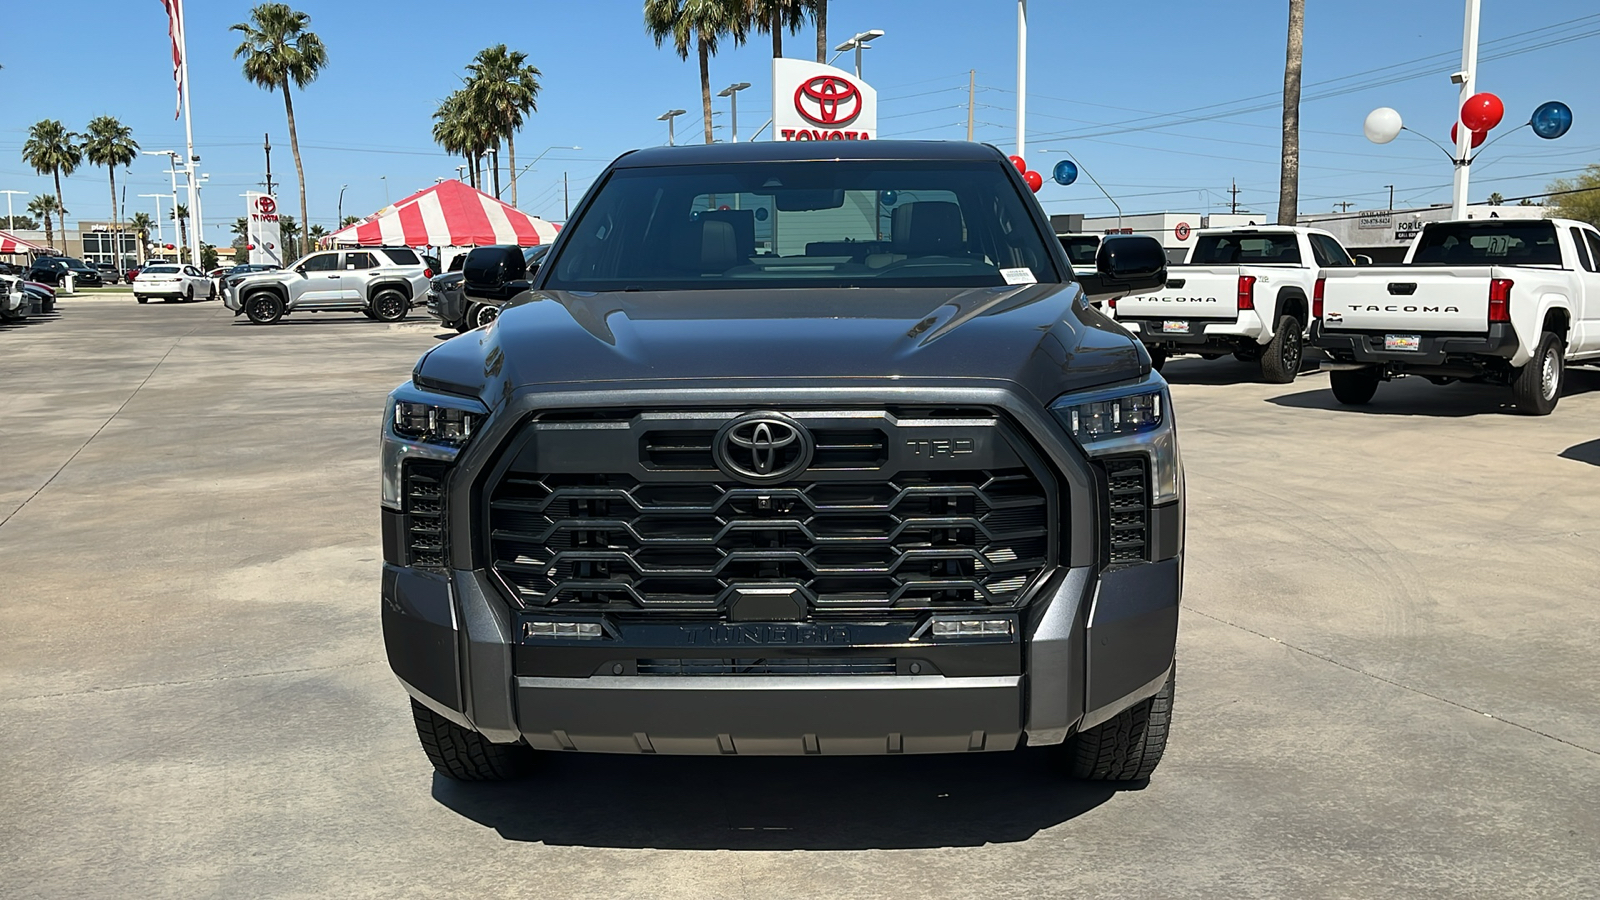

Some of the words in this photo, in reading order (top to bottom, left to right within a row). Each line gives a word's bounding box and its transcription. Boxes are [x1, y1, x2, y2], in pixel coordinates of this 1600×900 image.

[781, 129, 870, 141] TOYOTA
[1398, 222, 1413, 230] FOR
[1348, 304, 1459, 313] TACOMA
[906, 438, 975, 459] TRD
[679, 626, 851, 644] TUNDRA
